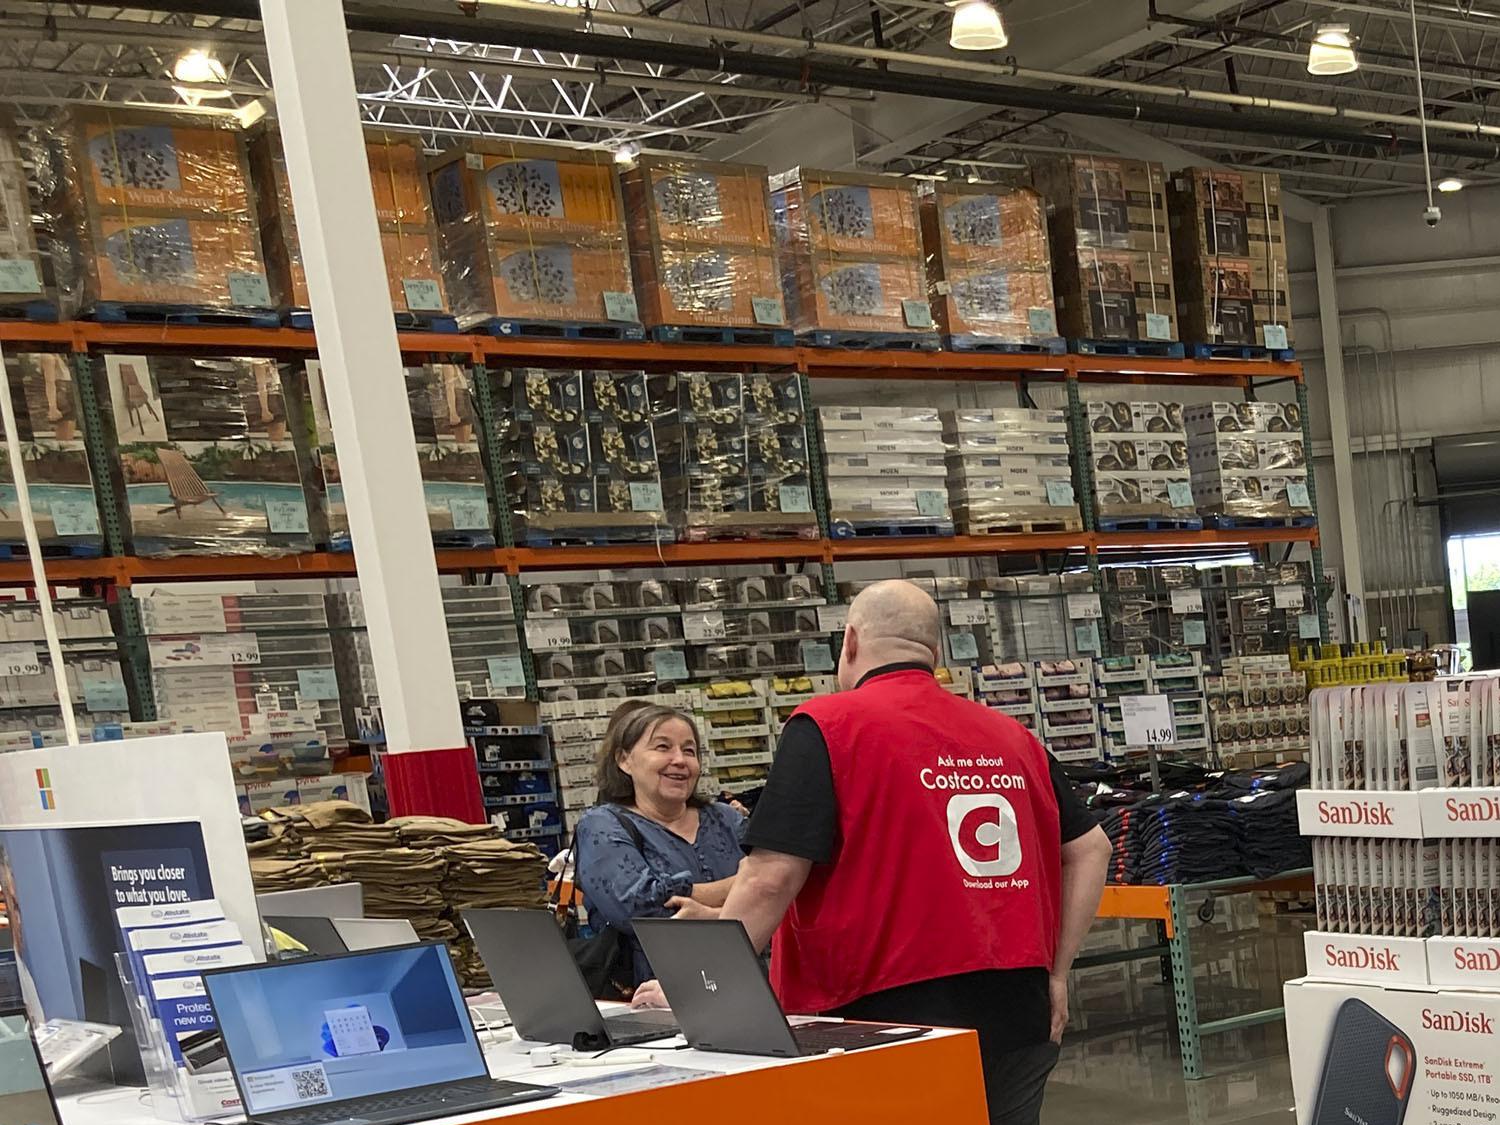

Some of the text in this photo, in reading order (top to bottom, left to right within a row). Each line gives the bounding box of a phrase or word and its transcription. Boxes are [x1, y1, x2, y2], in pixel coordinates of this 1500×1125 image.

[547, 637, 571, 646] 19.99
[231, 652, 259, 663] 12.99
[8, 664, 39, 675] 19.99
[1146, 728, 1172, 744] 14.99
[938, 755, 1004, 767] Ask me about
[920, 768, 1026, 790] Costco.com
[1319, 801, 1394, 826] SanDisk
[111, 866, 185, 886] Brings you closer
[1011, 878, 1029, 889] App
[116, 886, 191, 906] to what you love.
[1325, 944, 1400, 971] SanDisk
[177, 1003, 211, 1014] Protec
[175, 1015, 196, 1026] new
[1422, 1008, 1494, 1034] SanDisk
[1425, 1056, 1484, 1070] SanDisk Extreme
[1426, 1069, 1457, 1081] Portable
[1458, 1072, 1476, 1084] SSD,
[1431, 1089, 1440, 1099] Up
[1441, 1091, 1448, 1099] to
[1449, 1091, 1465, 1101] 1050
[1466, 1093, 1485, 1103] MB/s
[1432, 1104, 1497, 1121] Ruggedized Design
